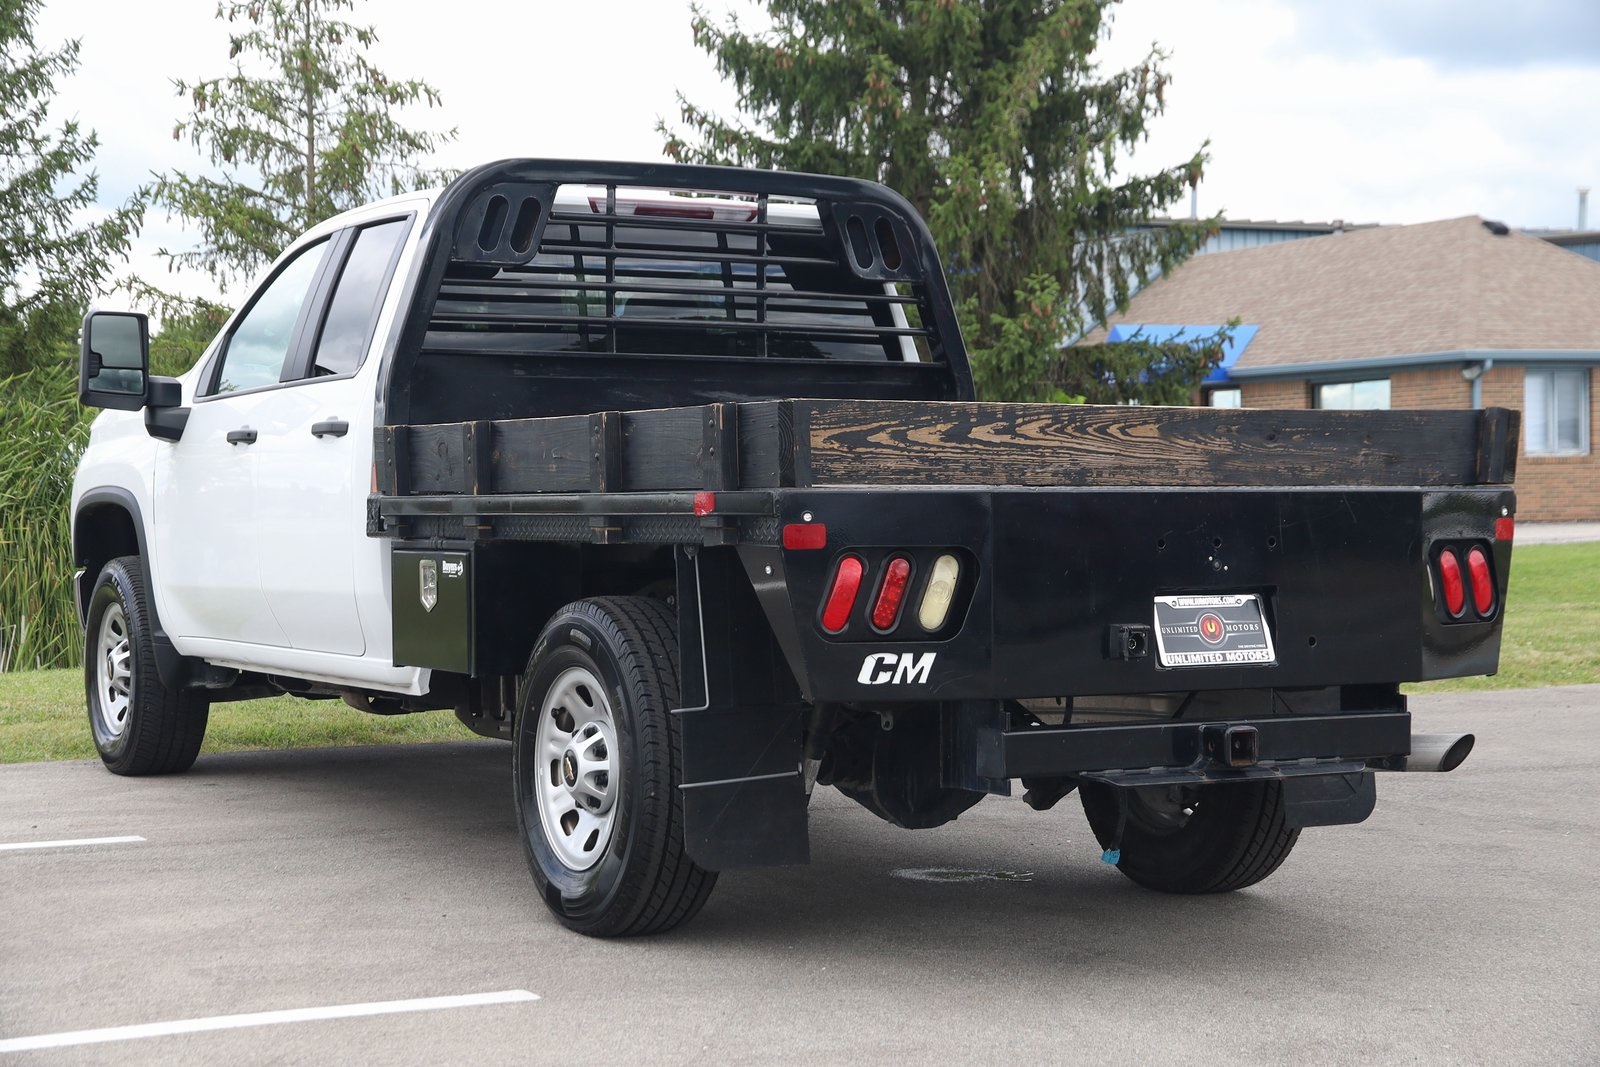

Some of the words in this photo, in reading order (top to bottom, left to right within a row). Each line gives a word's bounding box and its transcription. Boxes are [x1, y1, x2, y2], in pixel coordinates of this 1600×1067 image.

[1161, 626, 1199, 634] UNLIMITED
[1226, 623, 1259, 631] MOTORS
[1167, 653, 1223, 664] UNLIMITED
[1225, 651, 1270, 662] MOTORS
[857, 652, 937, 685] CM
